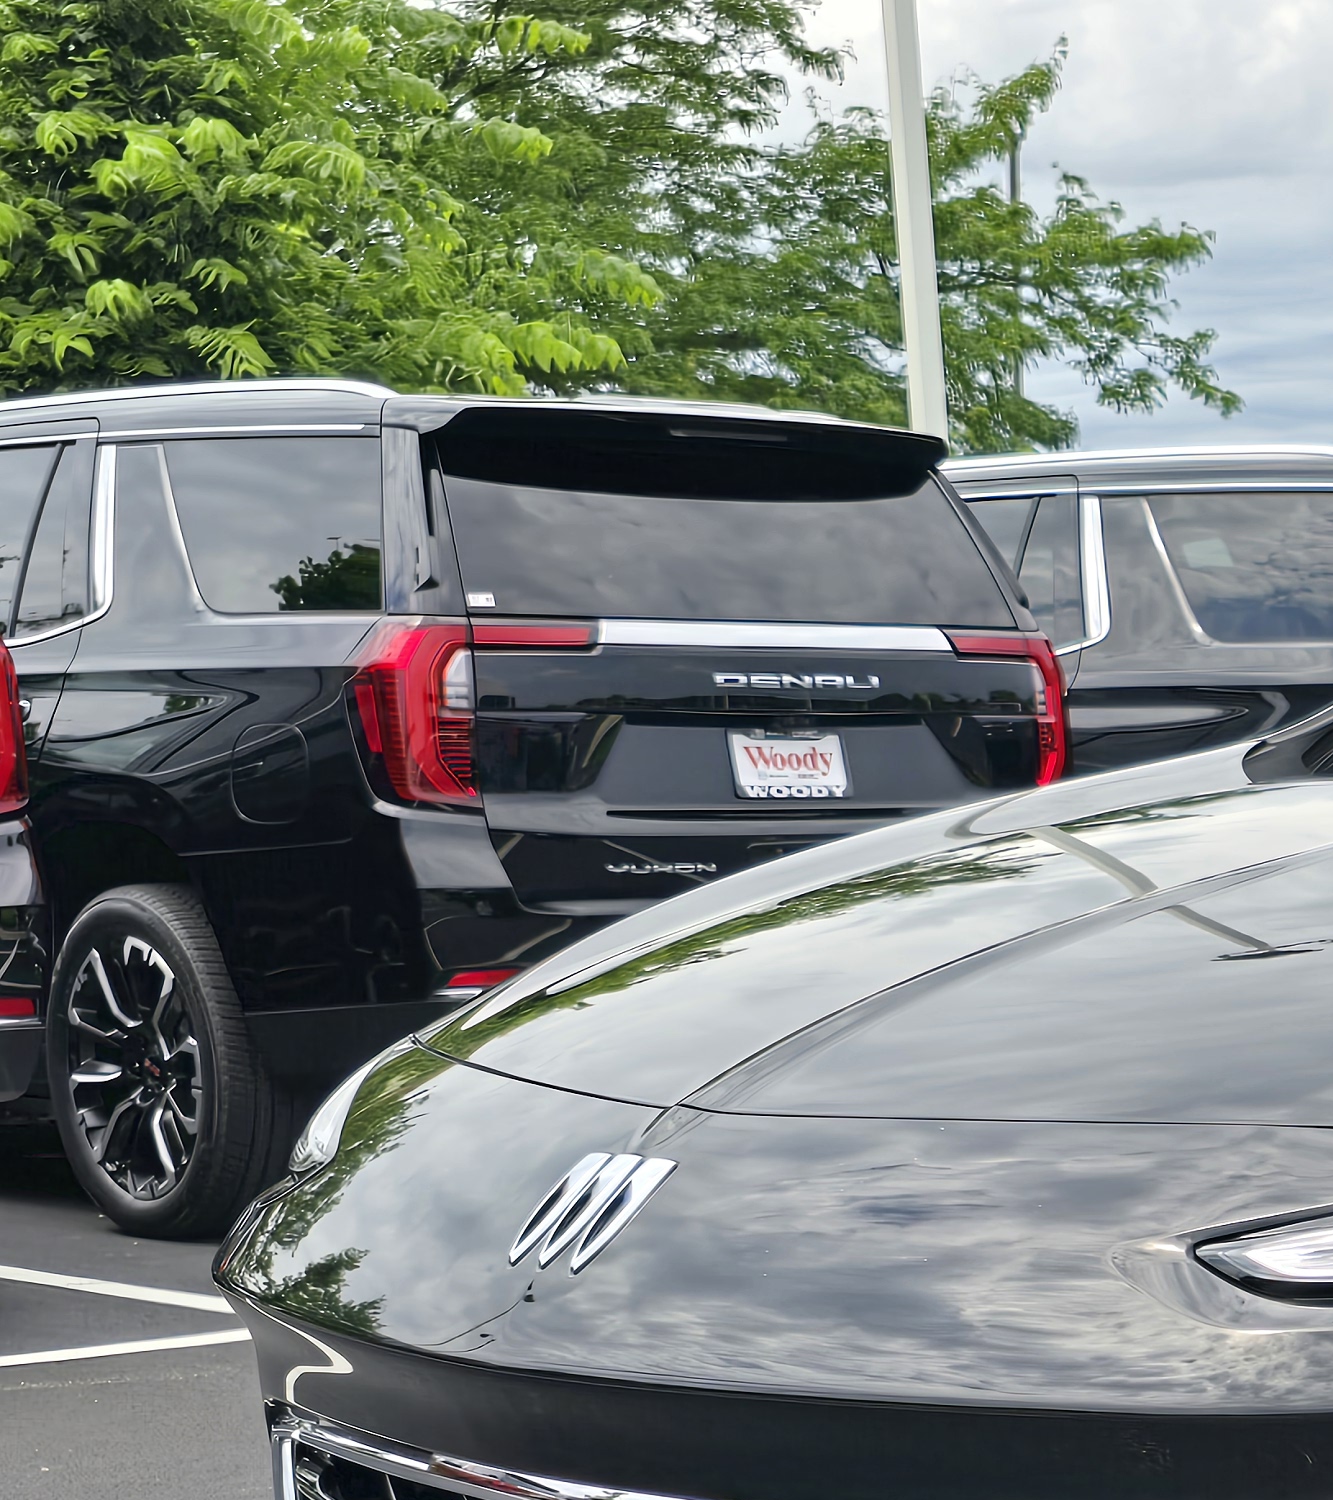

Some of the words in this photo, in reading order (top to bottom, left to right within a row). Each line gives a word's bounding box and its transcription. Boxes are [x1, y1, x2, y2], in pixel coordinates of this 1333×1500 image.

[712, 672, 880, 689] DENALI
[743, 746, 833, 776] Woody
[745, 785, 844, 798] WOODY
